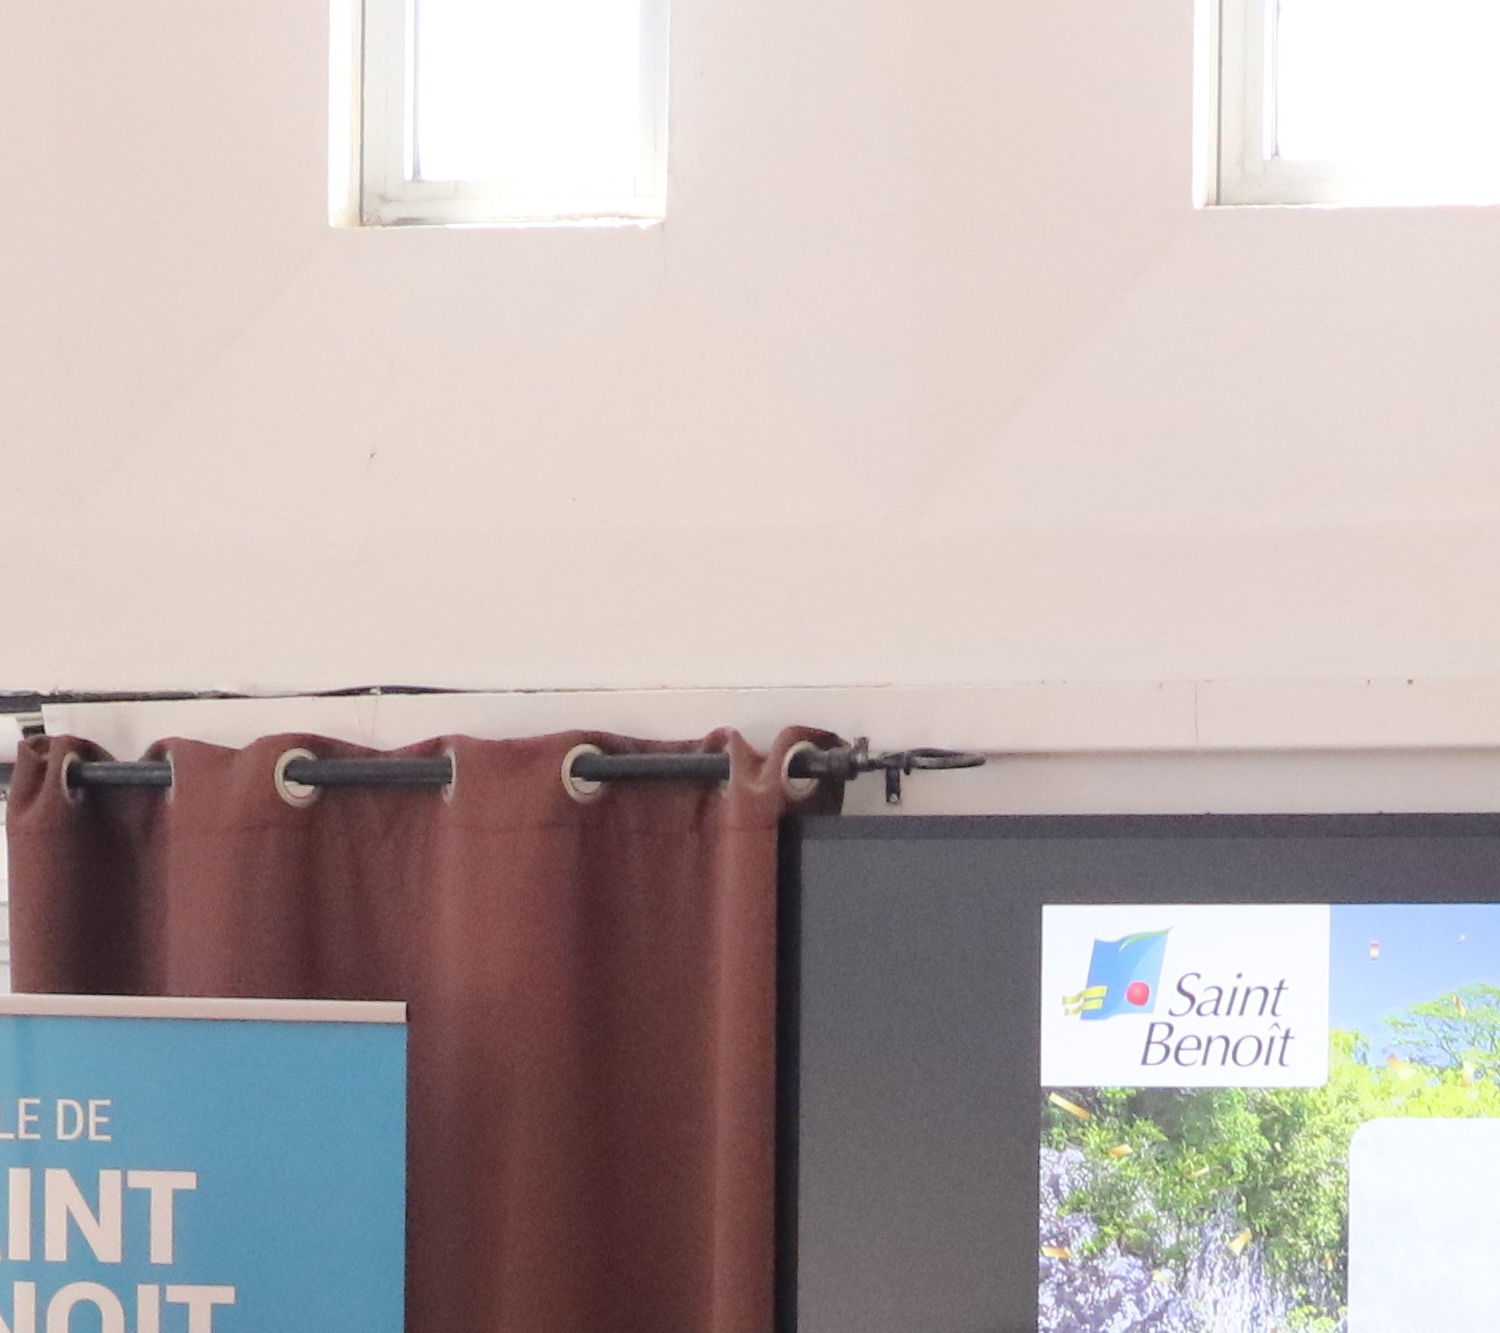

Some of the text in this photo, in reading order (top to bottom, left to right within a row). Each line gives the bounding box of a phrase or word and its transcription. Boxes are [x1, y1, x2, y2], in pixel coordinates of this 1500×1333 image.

[1168, 972, 1289, 1019] Saint
[1140, 1021, 1296, 1069] Benoît
[56, 1098, 113, 1142] DE
